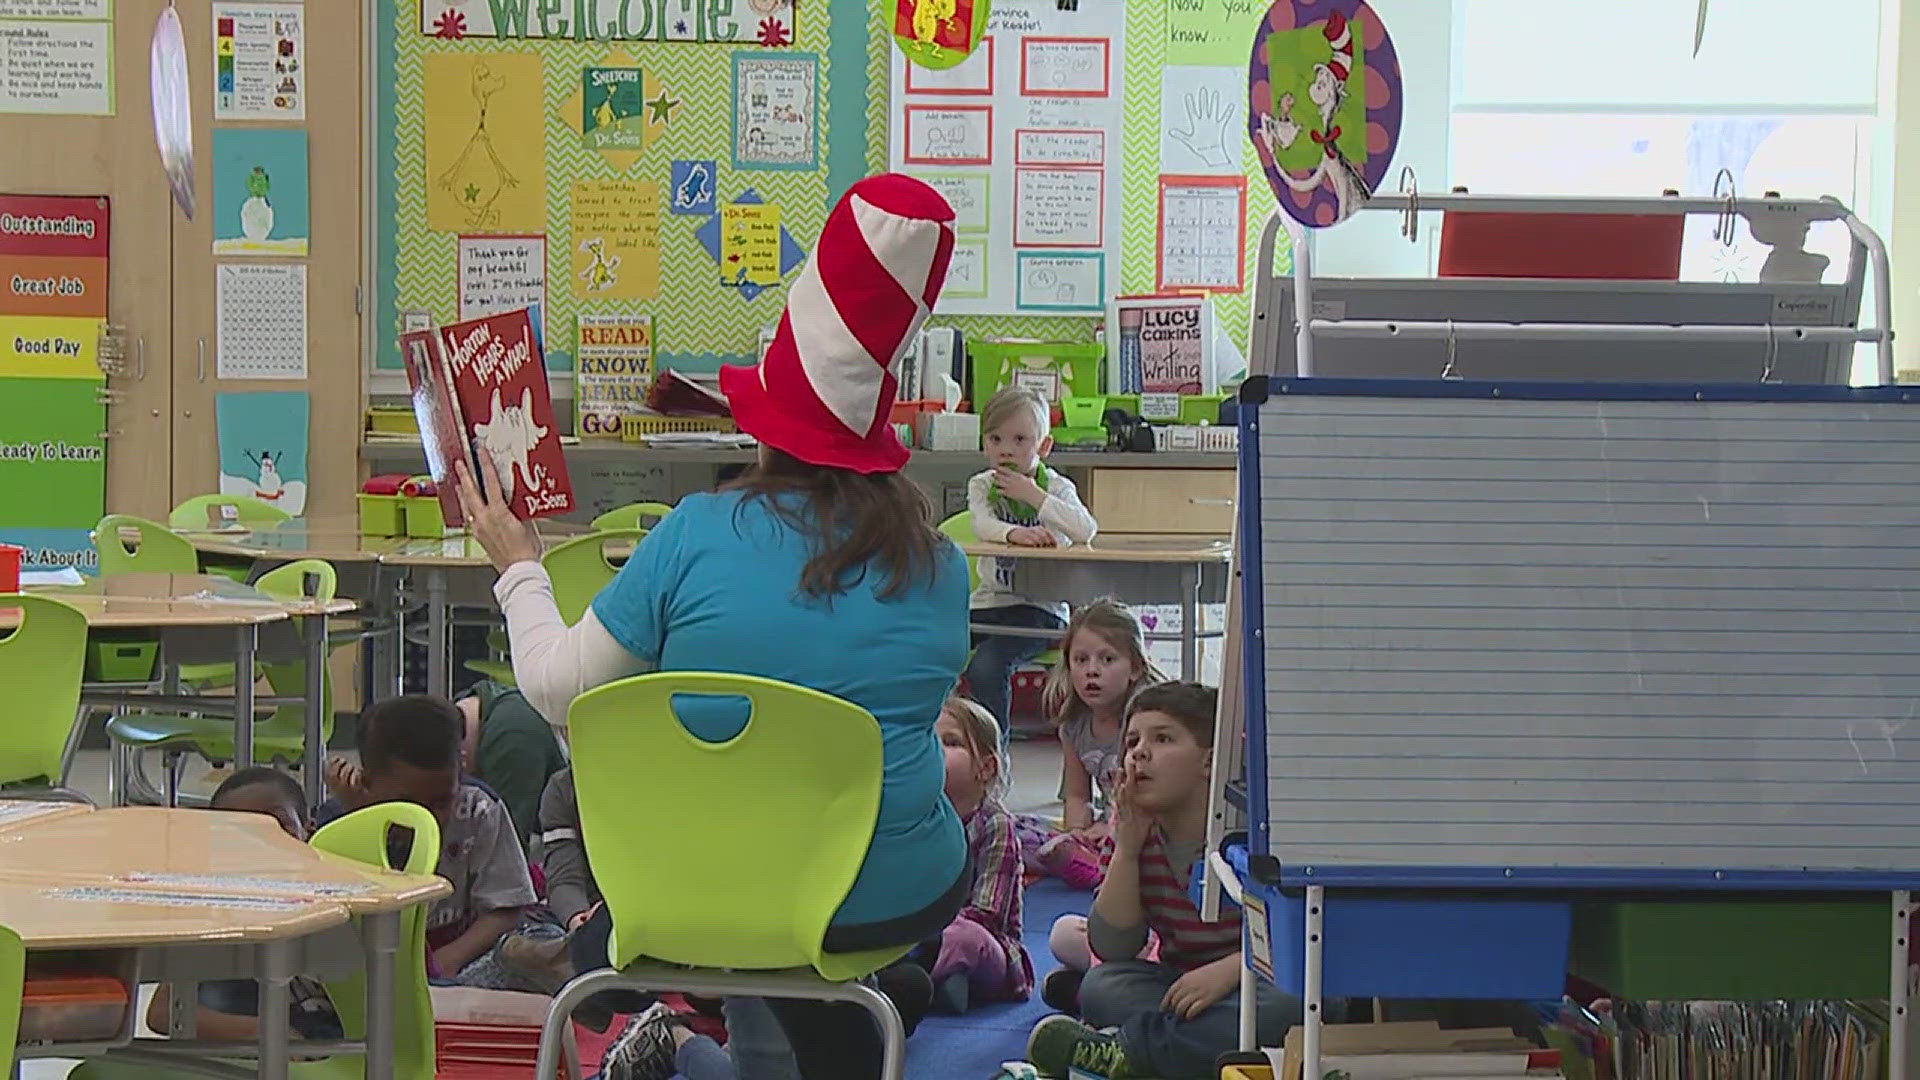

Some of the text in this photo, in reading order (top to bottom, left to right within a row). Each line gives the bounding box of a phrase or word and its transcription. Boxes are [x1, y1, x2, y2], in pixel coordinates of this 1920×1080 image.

[992, 8, 1029, 18] onvince
[2, 214, 94, 237] Outstanding
[468, 247, 496, 259] Thank
[498, 250, 514, 261] you
[467, 265, 483, 278] my
[12, 277, 83, 294] Great Job
[1778, 300, 1829, 312] Copernicus
[581, 327, 650, 346] READ,
[15, 337, 81, 357] Good Day
[581, 356, 650, 374] KNOW.
[0, 442, 102, 461] eady To Learn
[540, 489, 569, 510] Seuss
[38, 550, 82, 566] About
[85, 550, 98, 566] It
